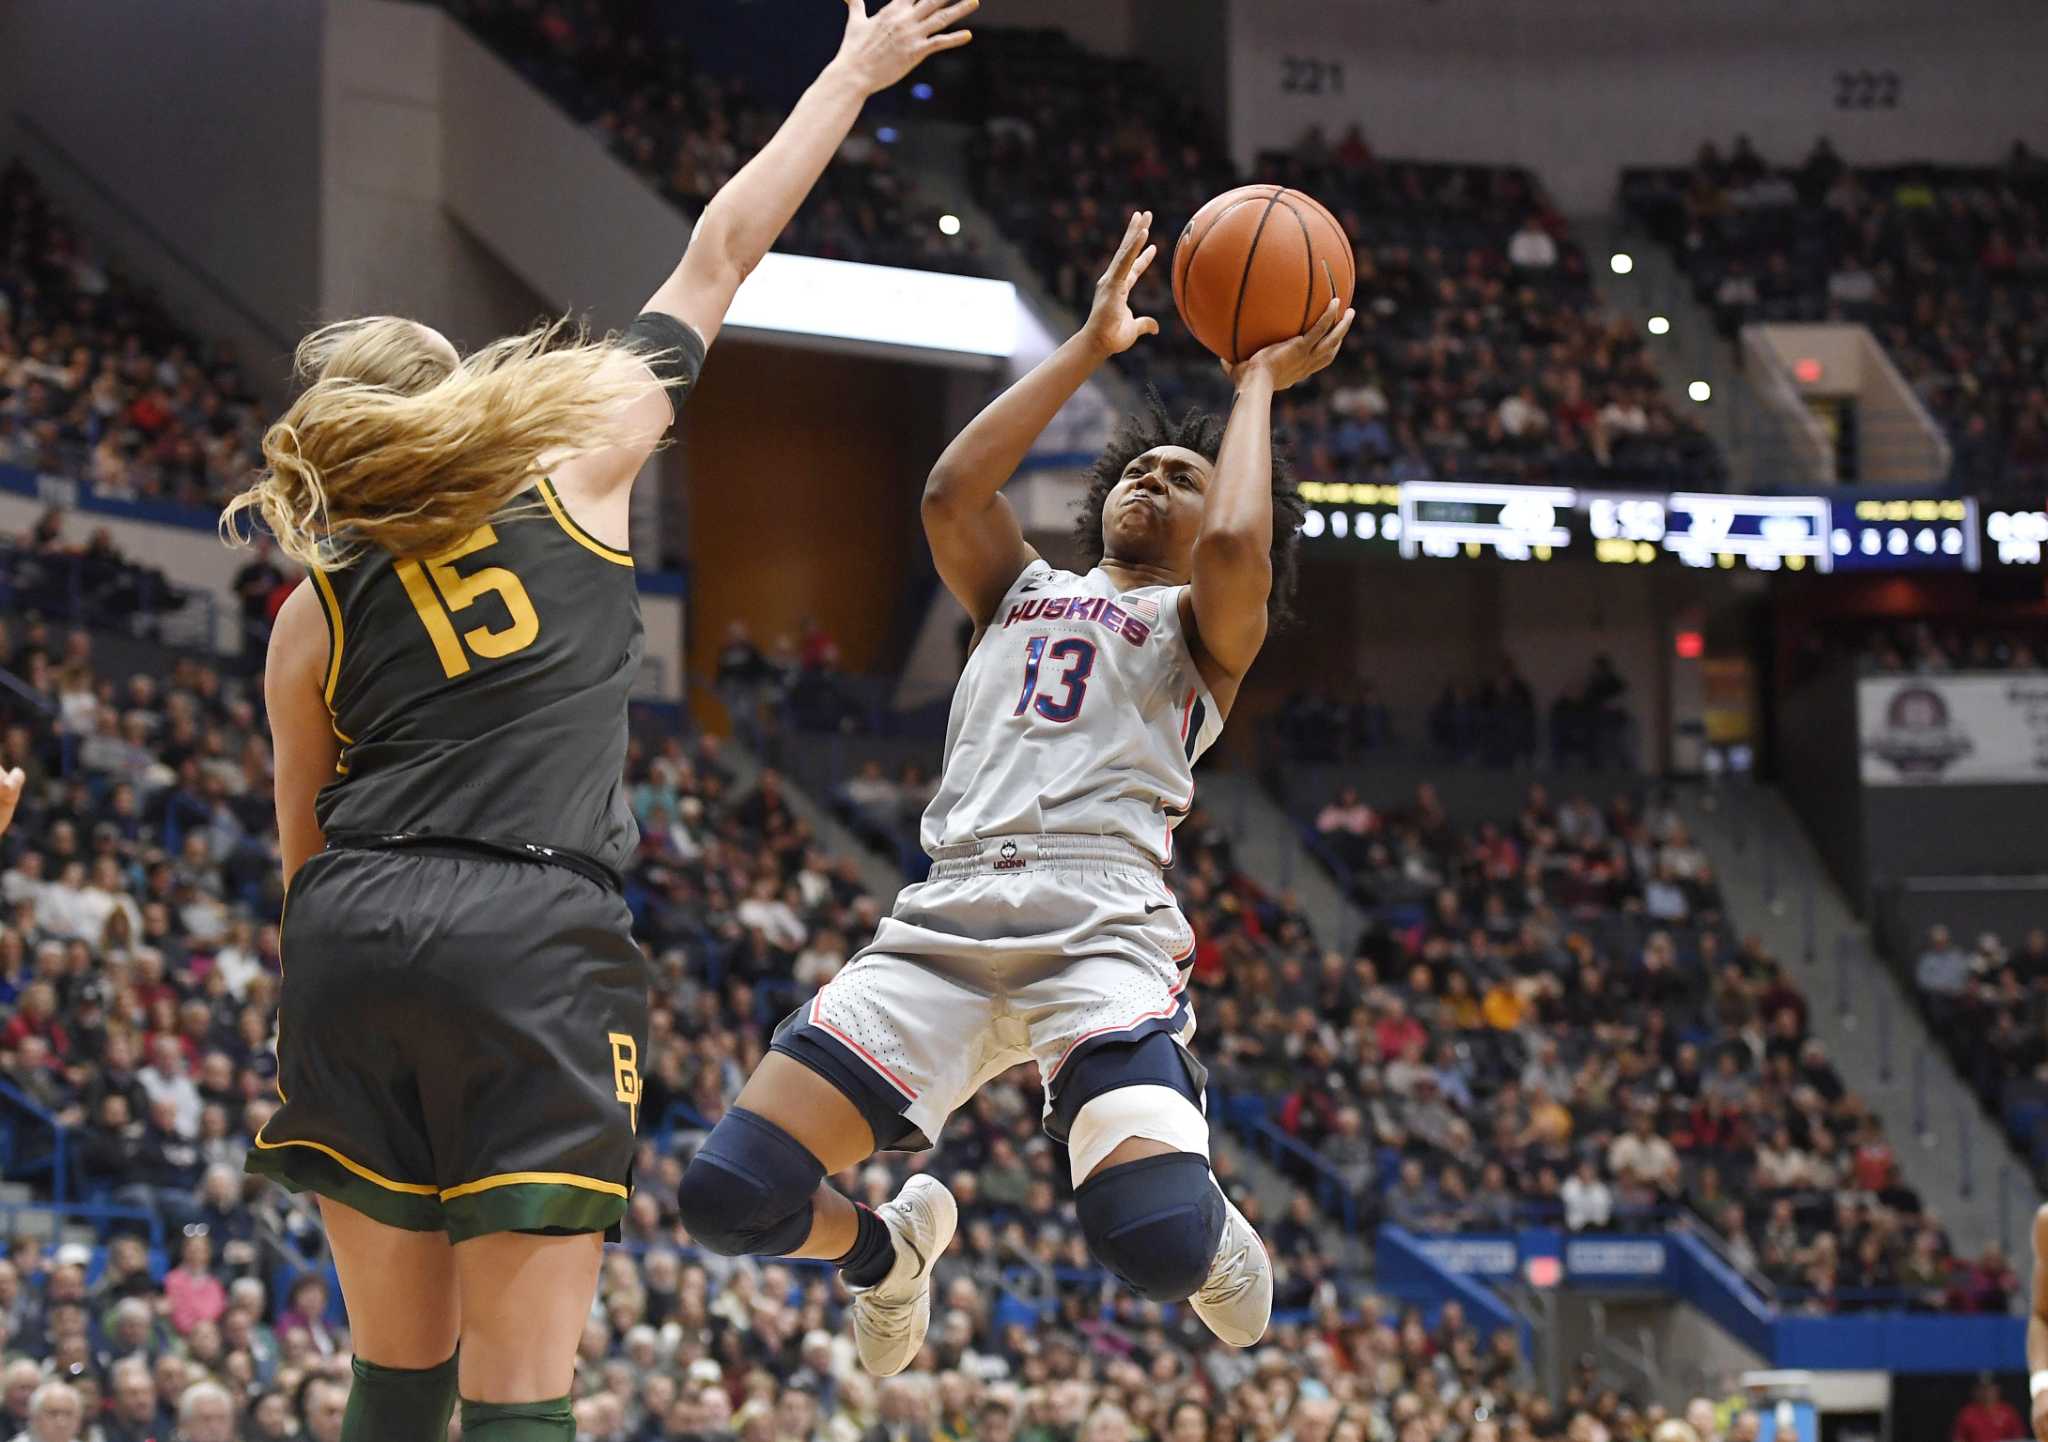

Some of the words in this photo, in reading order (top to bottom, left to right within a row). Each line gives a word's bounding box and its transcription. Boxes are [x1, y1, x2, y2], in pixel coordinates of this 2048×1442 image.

[393, 523, 540, 680] 15
[1002, 596, 1151, 647] HUSKIES
[1013, 635, 1097, 723] 13
[993, 859, 1026, 869] UCONN
